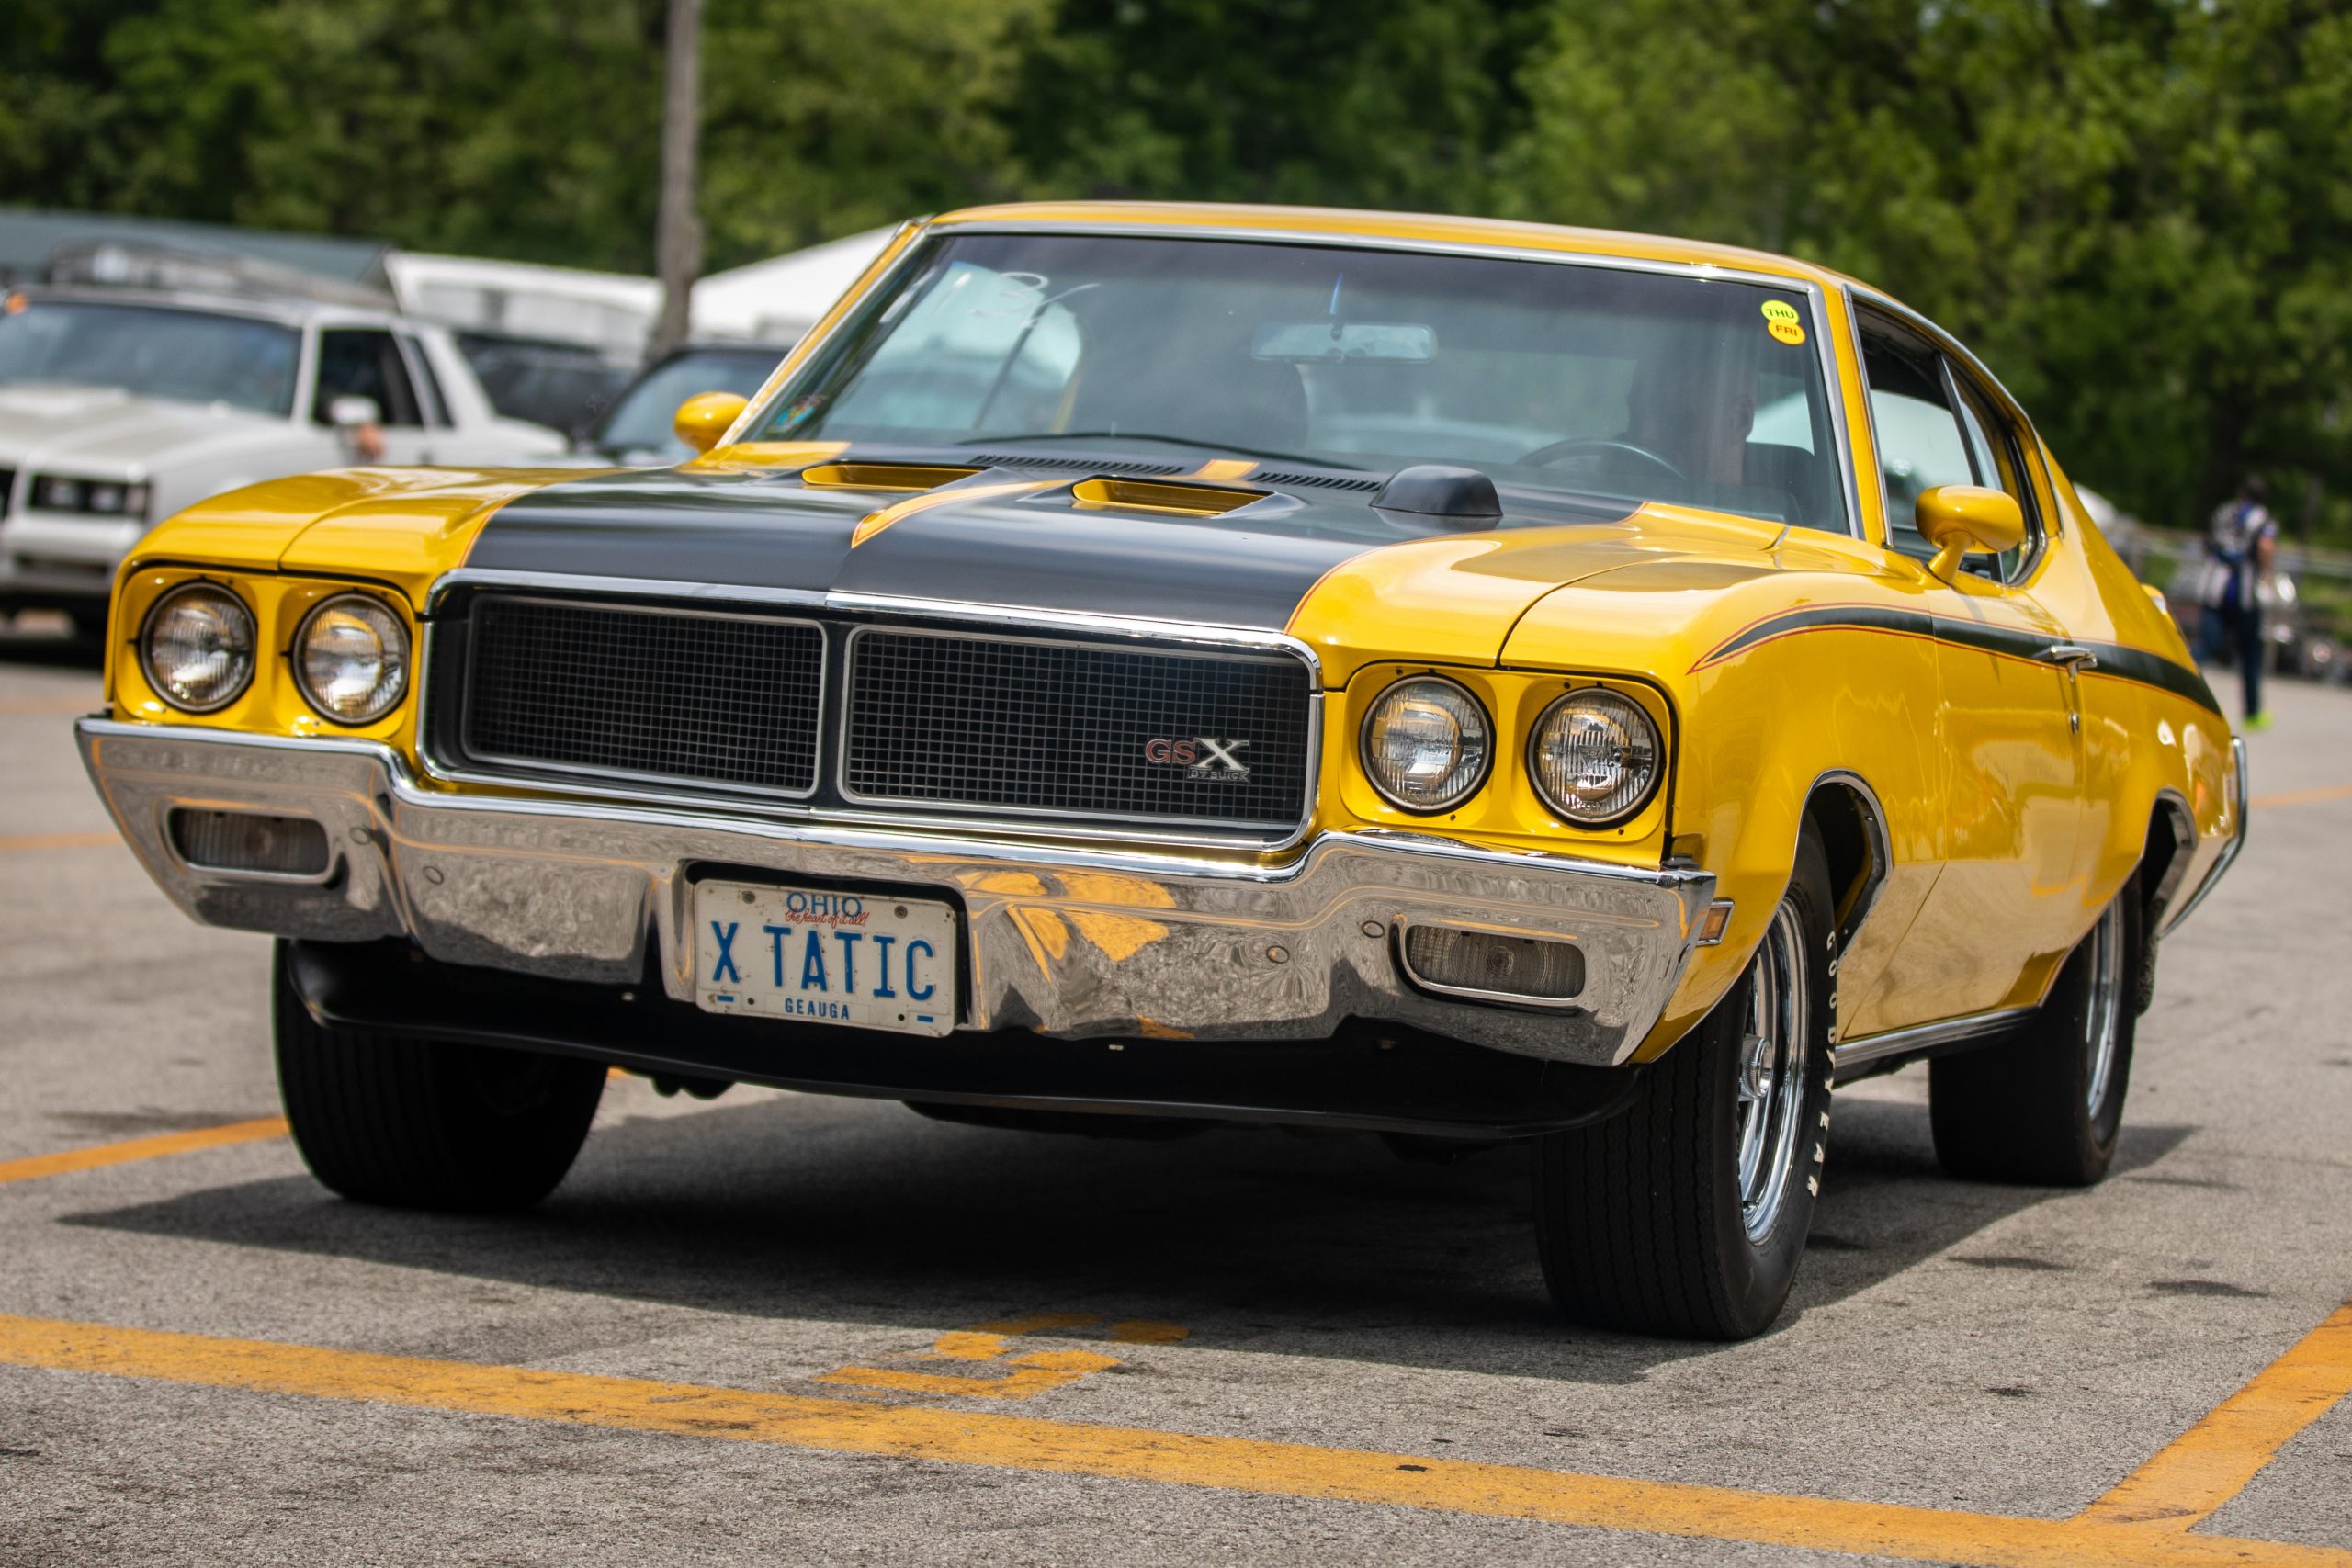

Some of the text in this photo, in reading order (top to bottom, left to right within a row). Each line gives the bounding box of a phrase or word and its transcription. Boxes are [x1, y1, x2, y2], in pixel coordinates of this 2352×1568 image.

[1767, 309, 1794, 319] THU
[1776, 324, 1798, 336] FRI
[1145, 737, 1250, 772] GSX
[1210, 771, 1250, 782] BUICK
[786, 891, 863, 918] OHIO
[710, 920, 934, 1001] X TATIC
[785, 998, 850, 1021] GEAUGA
